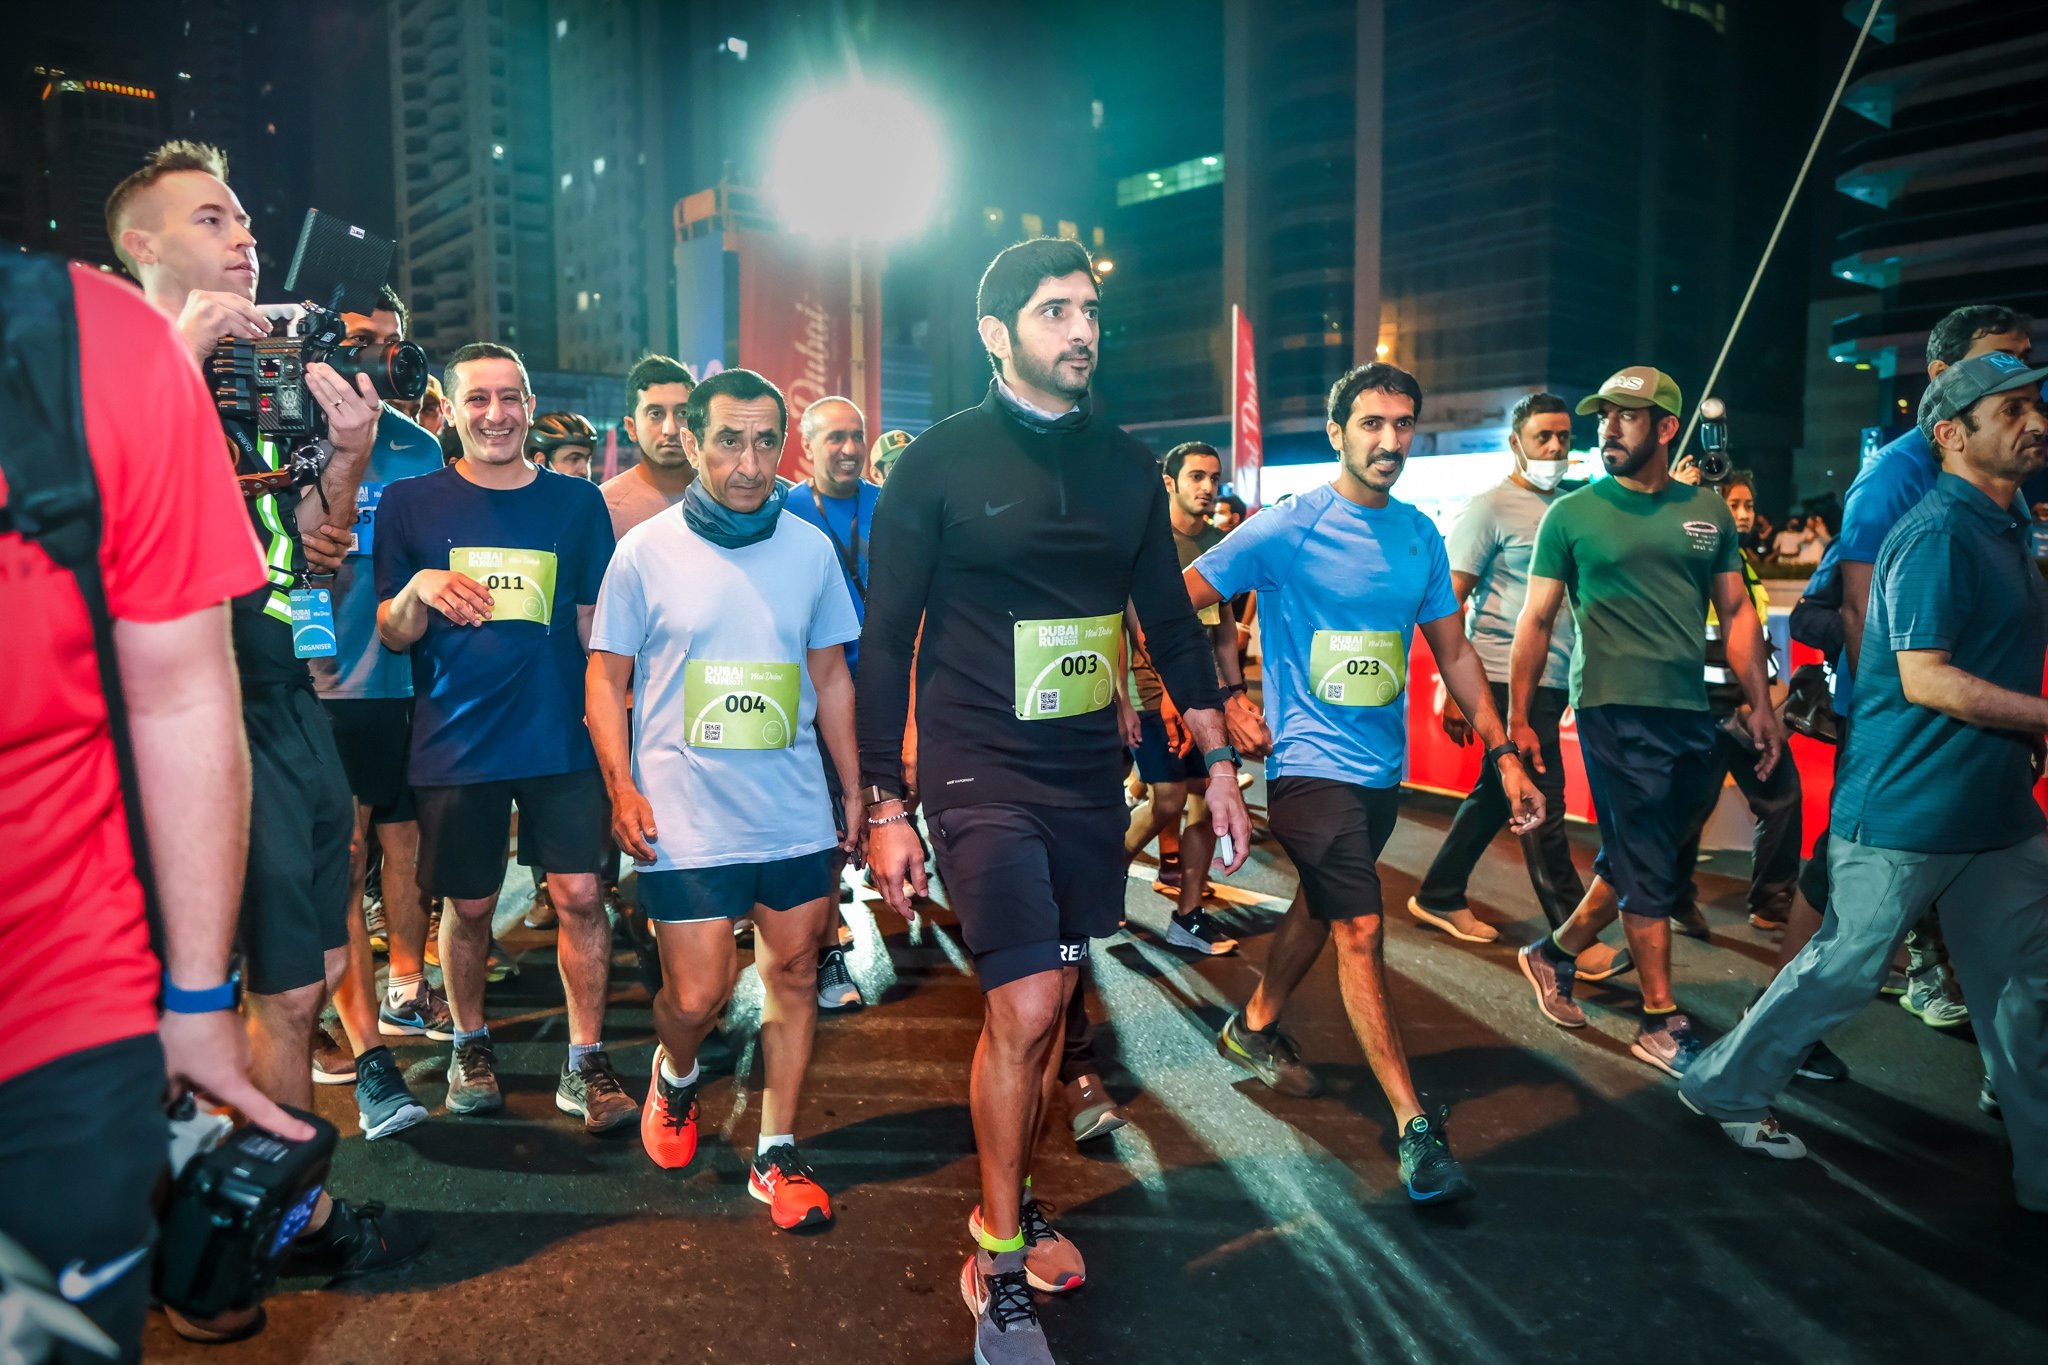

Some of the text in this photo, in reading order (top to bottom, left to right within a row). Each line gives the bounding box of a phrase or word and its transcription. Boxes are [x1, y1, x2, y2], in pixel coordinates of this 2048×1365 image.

[487, 575, 524, 590] 011
[1039, 625, 1078, 637] DUBAI
[1039, 636, 1063, 647] RUN
[1330, 634, 1363, 644] DUBAI
[298, 643, 332, 651] ORGANISER
[704, 665, 744, 676] DUBAI
[1061, 654, 1098, 677] 003
[1346, 660, 1380, 675] 023
[704, 675, 729, 685] RUN
[725, 694, 766, 713] 004
